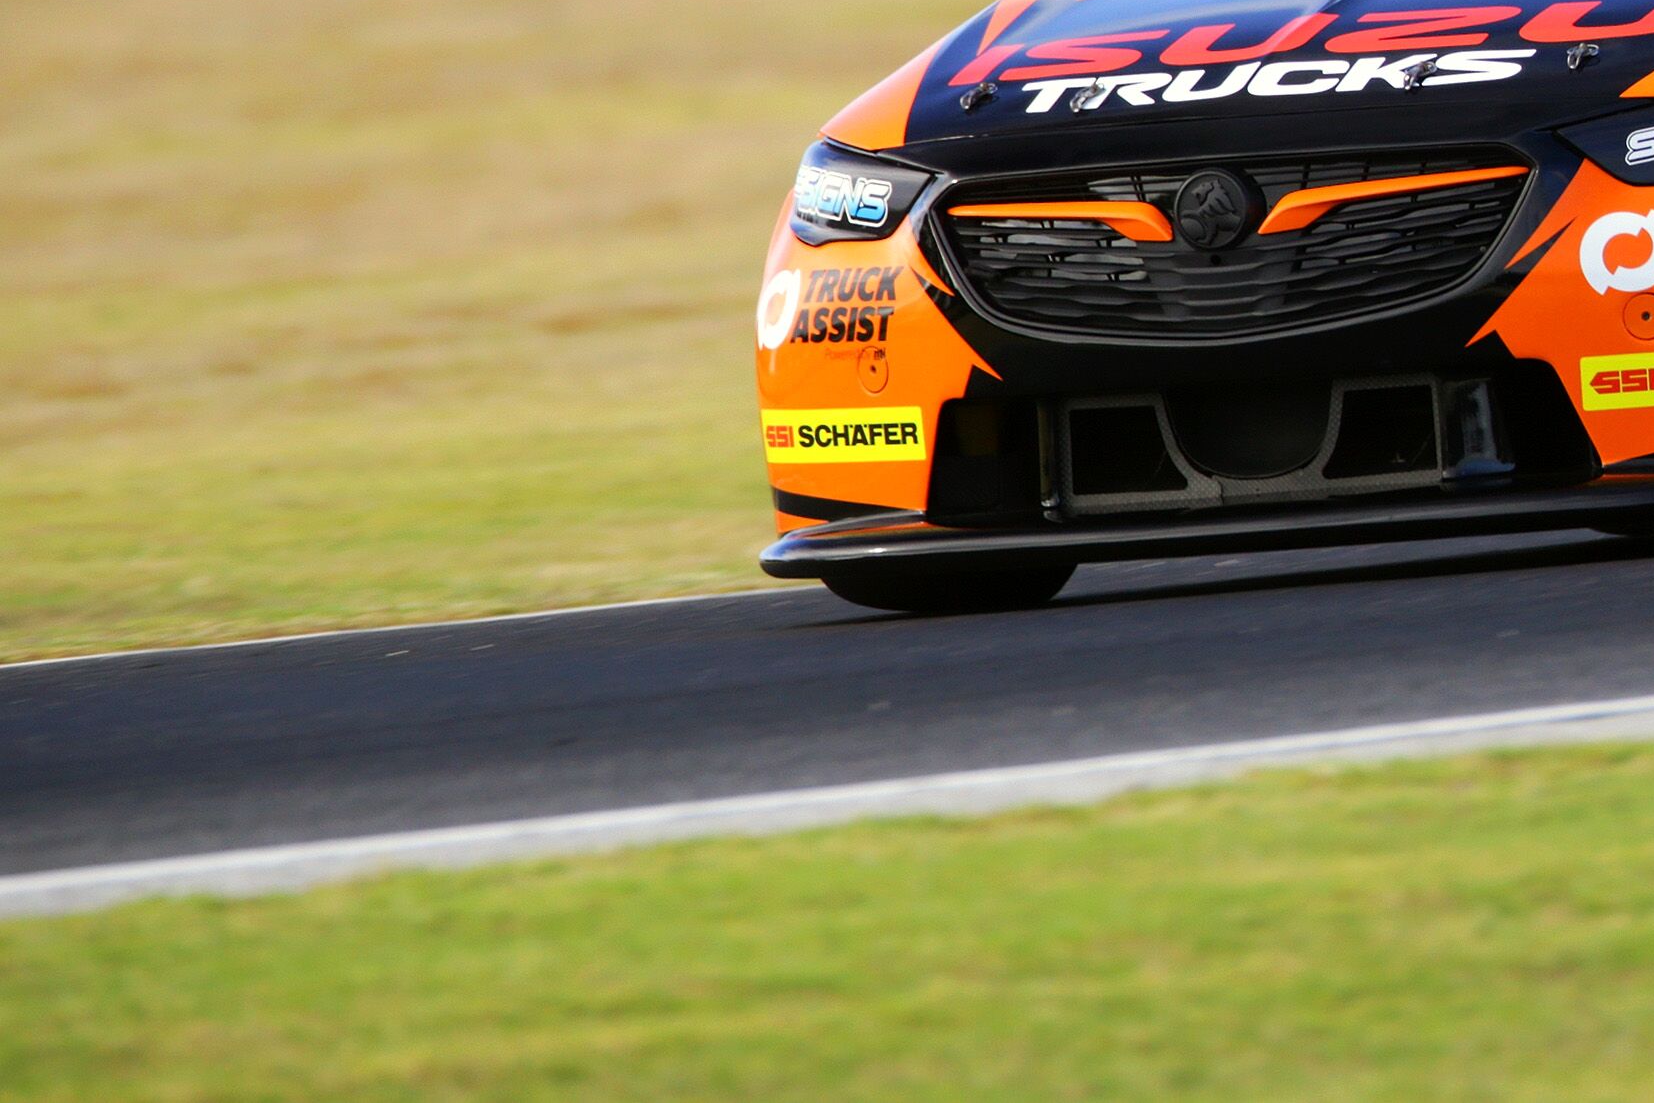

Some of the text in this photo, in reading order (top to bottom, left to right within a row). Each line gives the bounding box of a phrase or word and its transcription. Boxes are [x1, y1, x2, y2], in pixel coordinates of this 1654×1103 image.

[1021, 48, 1537, 114] TRUCKS
[804, 265, 904, 303] TRUCK
[790, 306, 895, 344] ASSIST
[766, 422, 919, 448] SSI SCHÄFER
